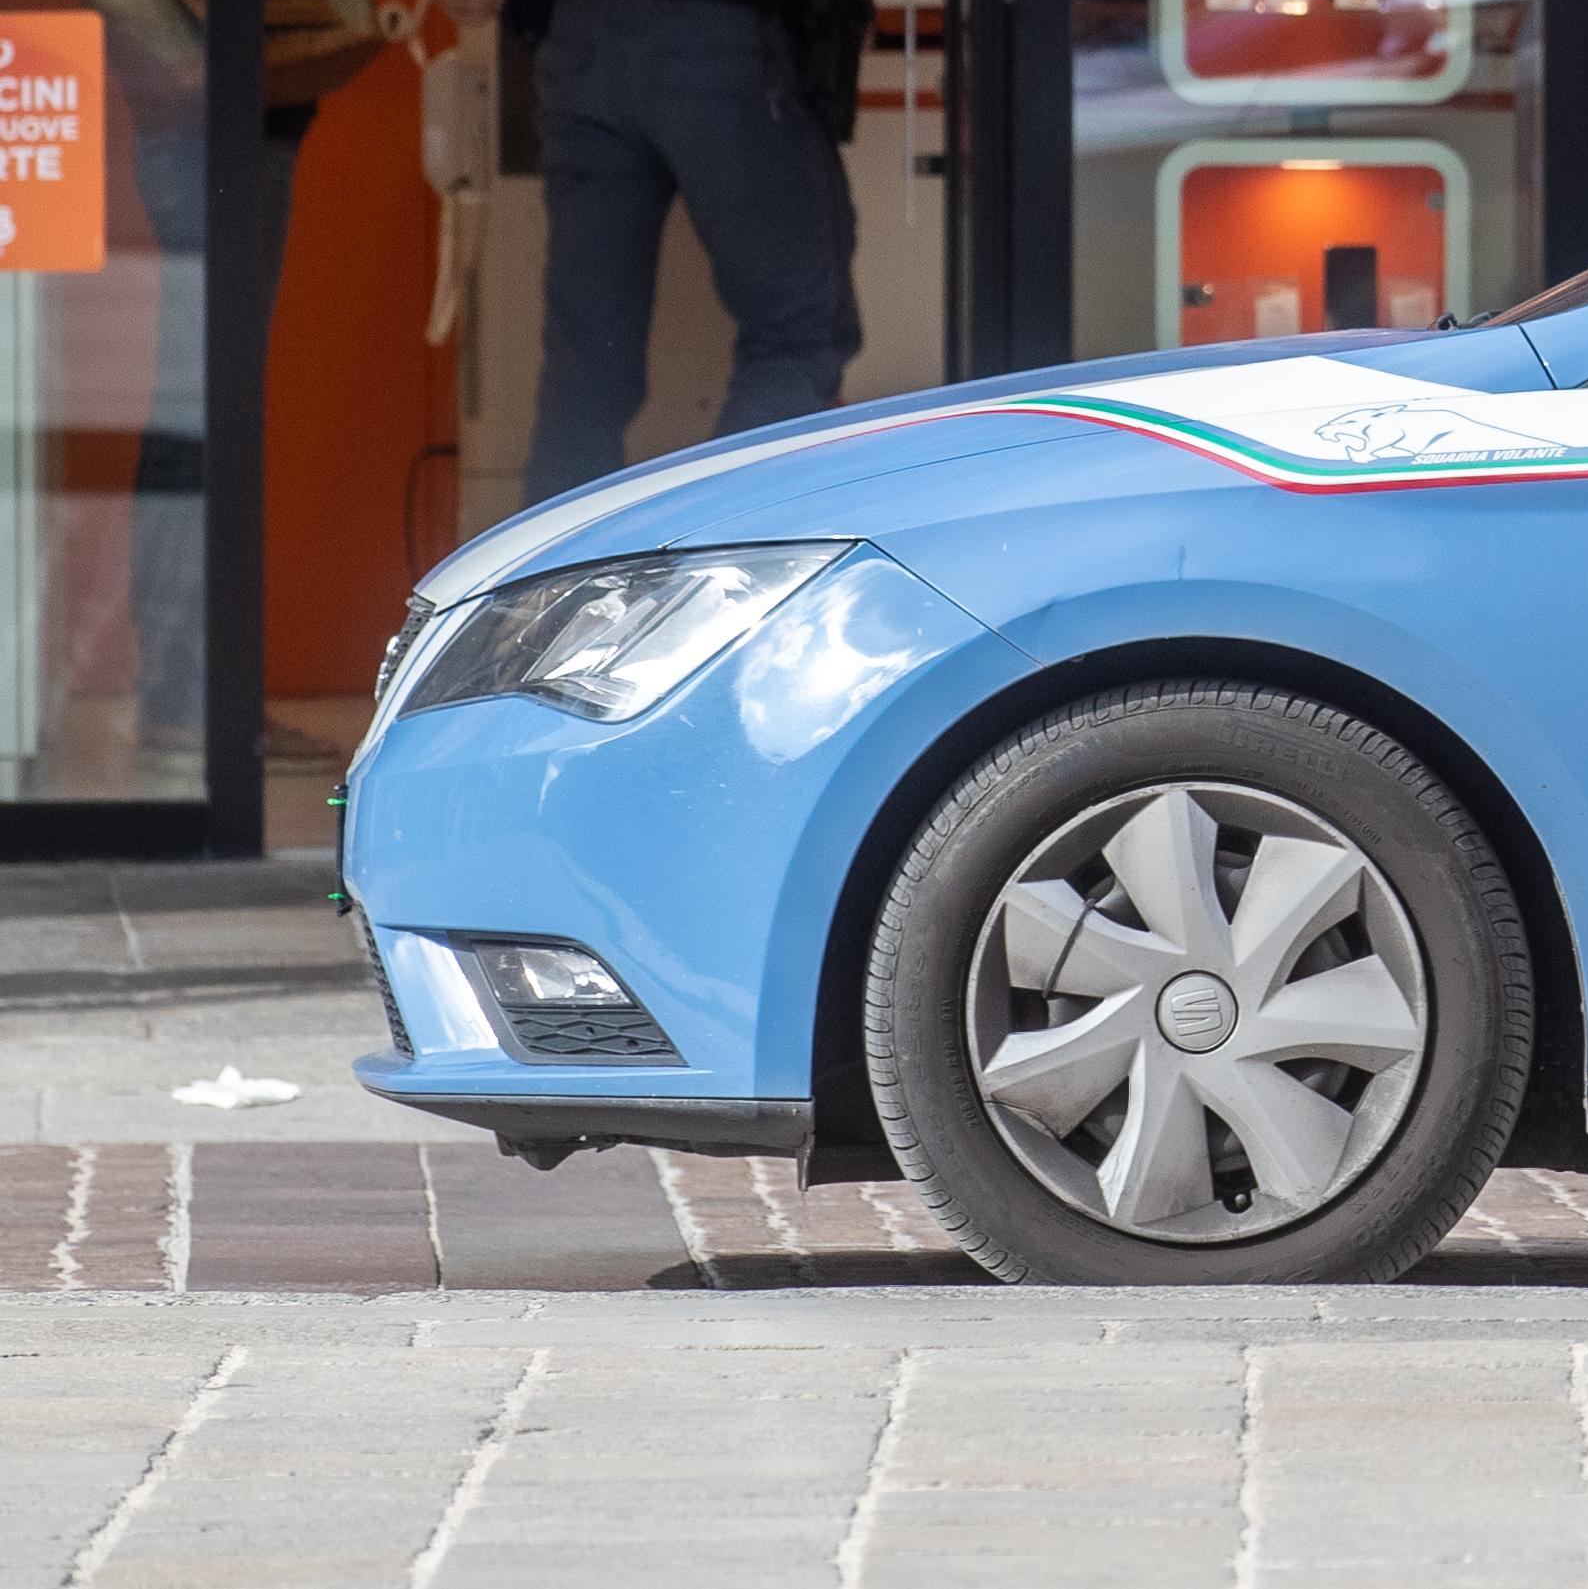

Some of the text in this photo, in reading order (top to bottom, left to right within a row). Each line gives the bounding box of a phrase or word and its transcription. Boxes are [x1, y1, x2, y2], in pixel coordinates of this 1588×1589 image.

[0, 76, 79, 111] CINI
[1411, 446, 1567, 465] SQUADRA VOLANTE
